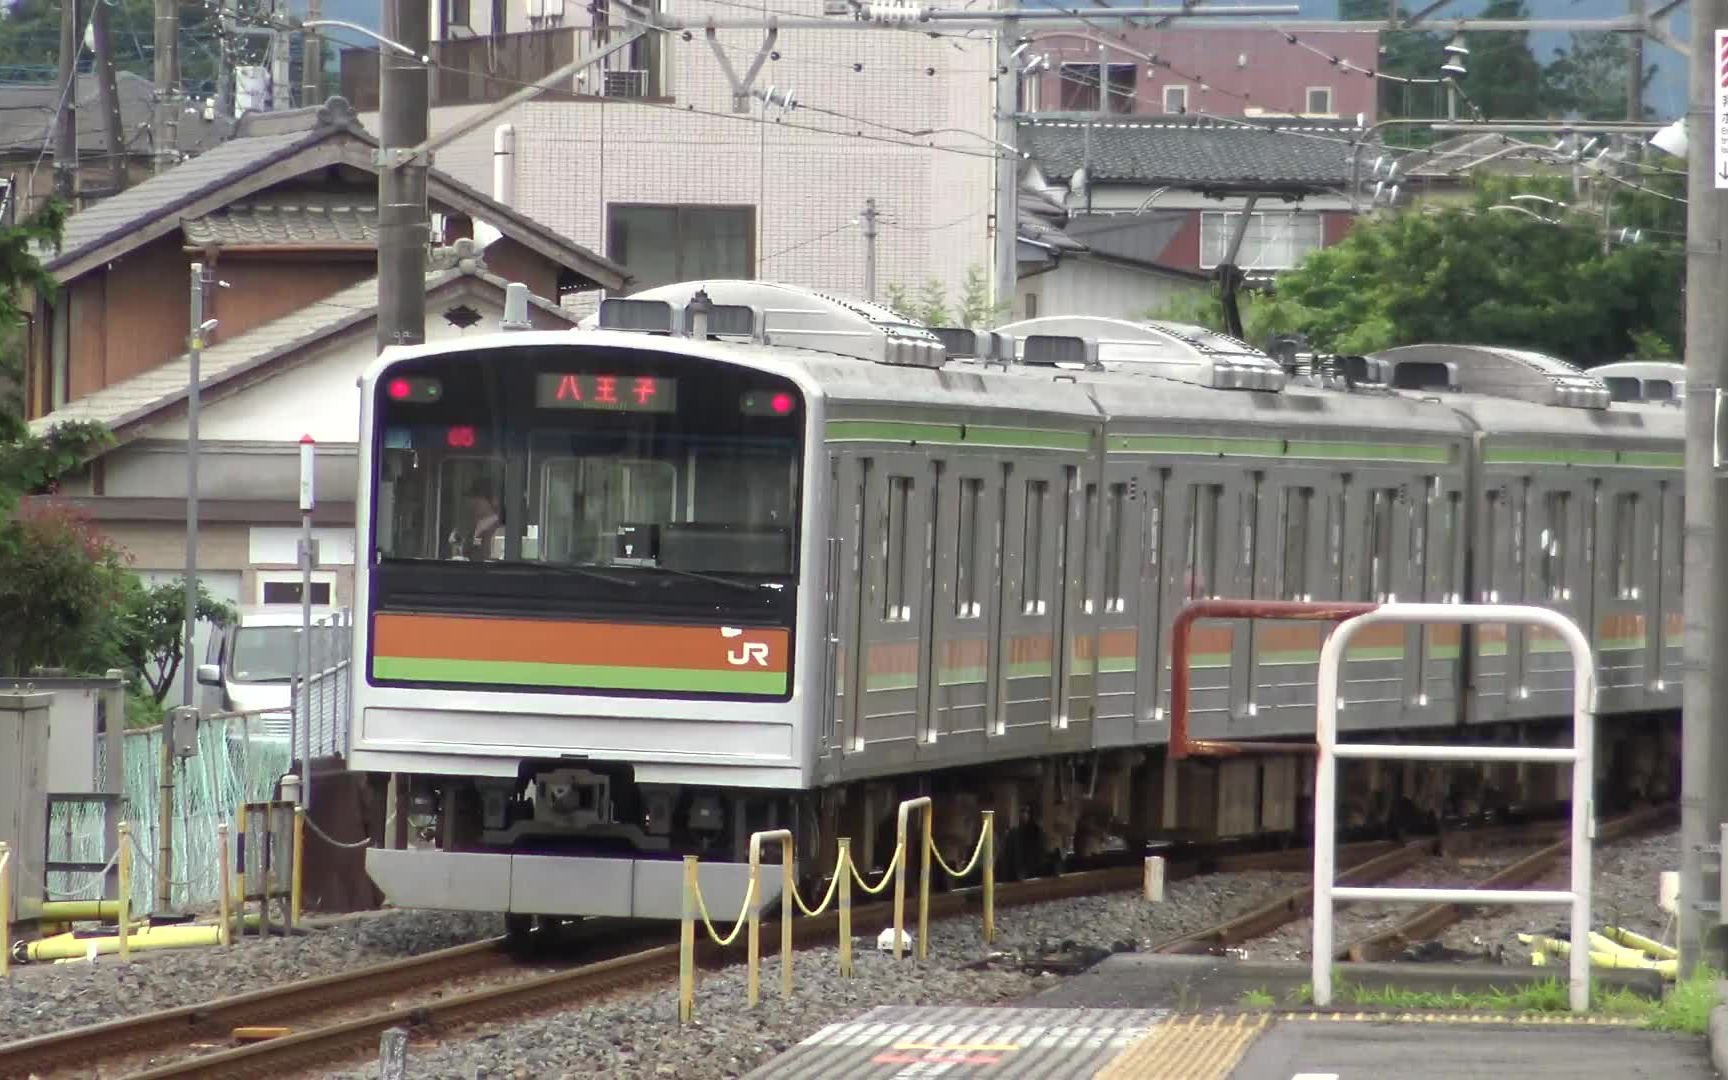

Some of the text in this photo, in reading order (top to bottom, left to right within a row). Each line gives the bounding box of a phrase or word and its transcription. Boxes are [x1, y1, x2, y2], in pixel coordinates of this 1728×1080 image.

[555, 375, 656, 404] 八王子
[727, 642, 769, 667] JR
